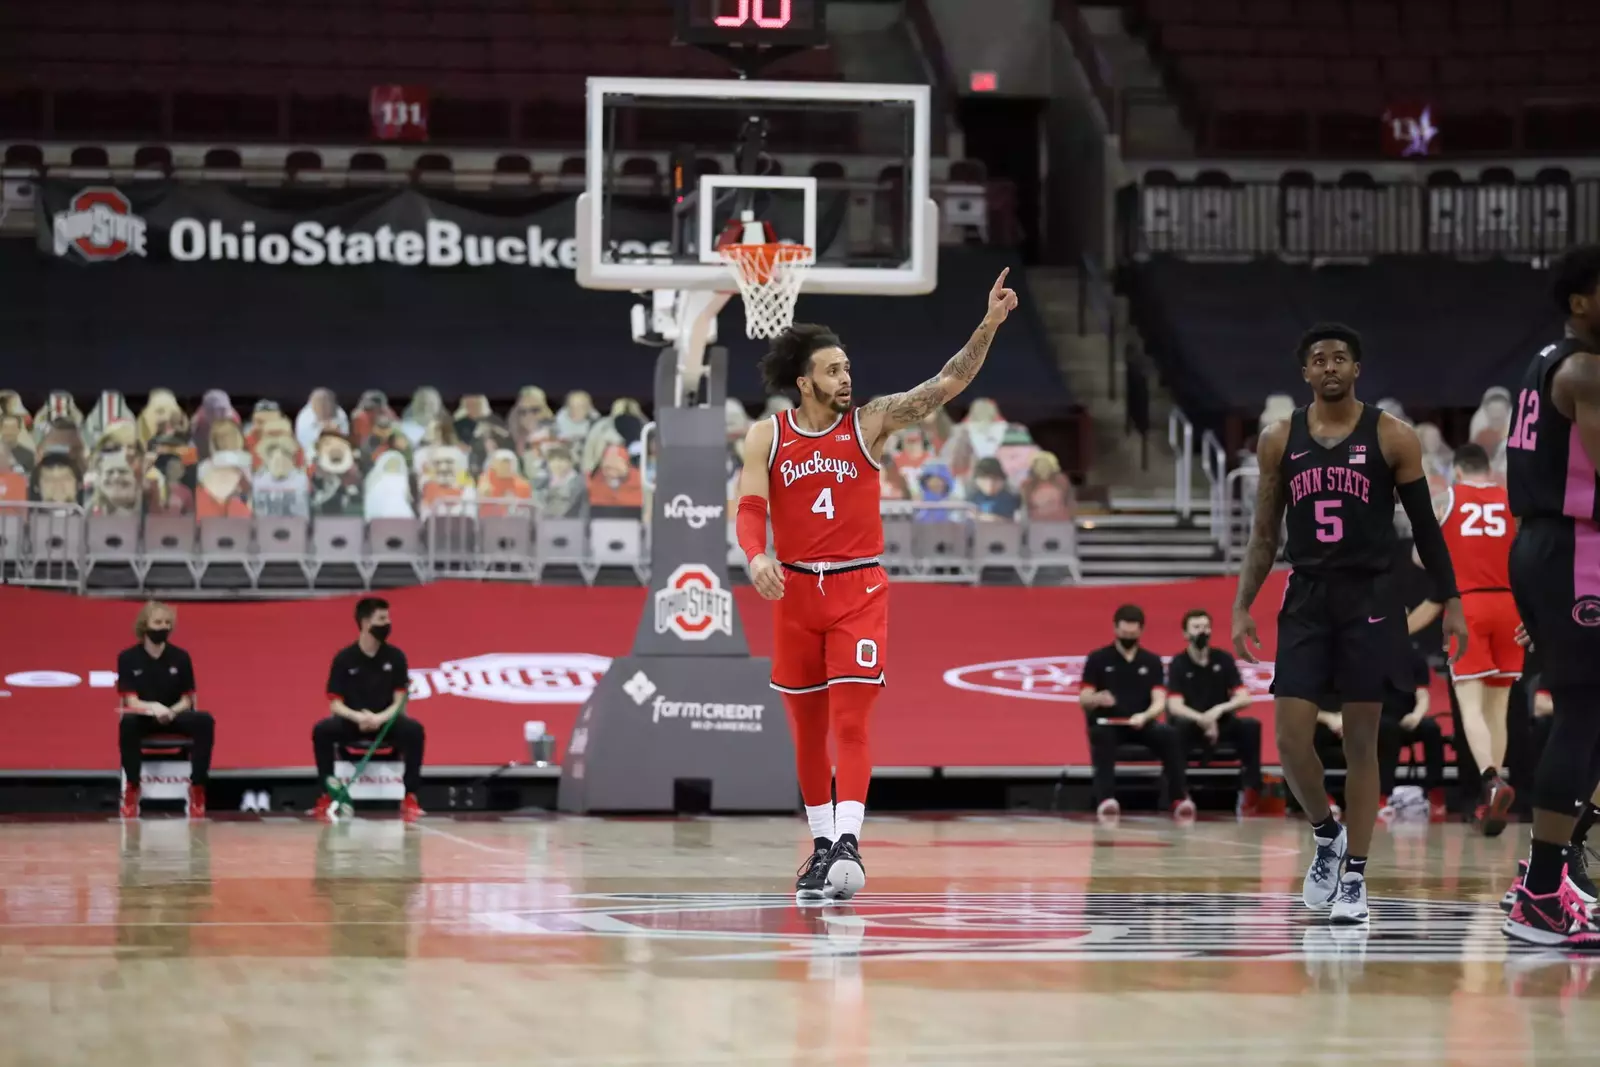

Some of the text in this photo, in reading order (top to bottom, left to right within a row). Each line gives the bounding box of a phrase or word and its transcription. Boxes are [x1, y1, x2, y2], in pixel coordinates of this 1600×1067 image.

[1508, 388, 1540, 451] 12
[780, 450, 858, 487] Buckeyes
[1290, 466, 1371, 507] PENN STATE
[663, 494, 723, 529] Kroger
[811, 487, 835, 520] 4
[1314, 499, 1344, 543] 5
[1460, 502, 1506, 537] 25
[687, 585, 732, 636] STATE
[140, 775, 192, 785] ONDA
